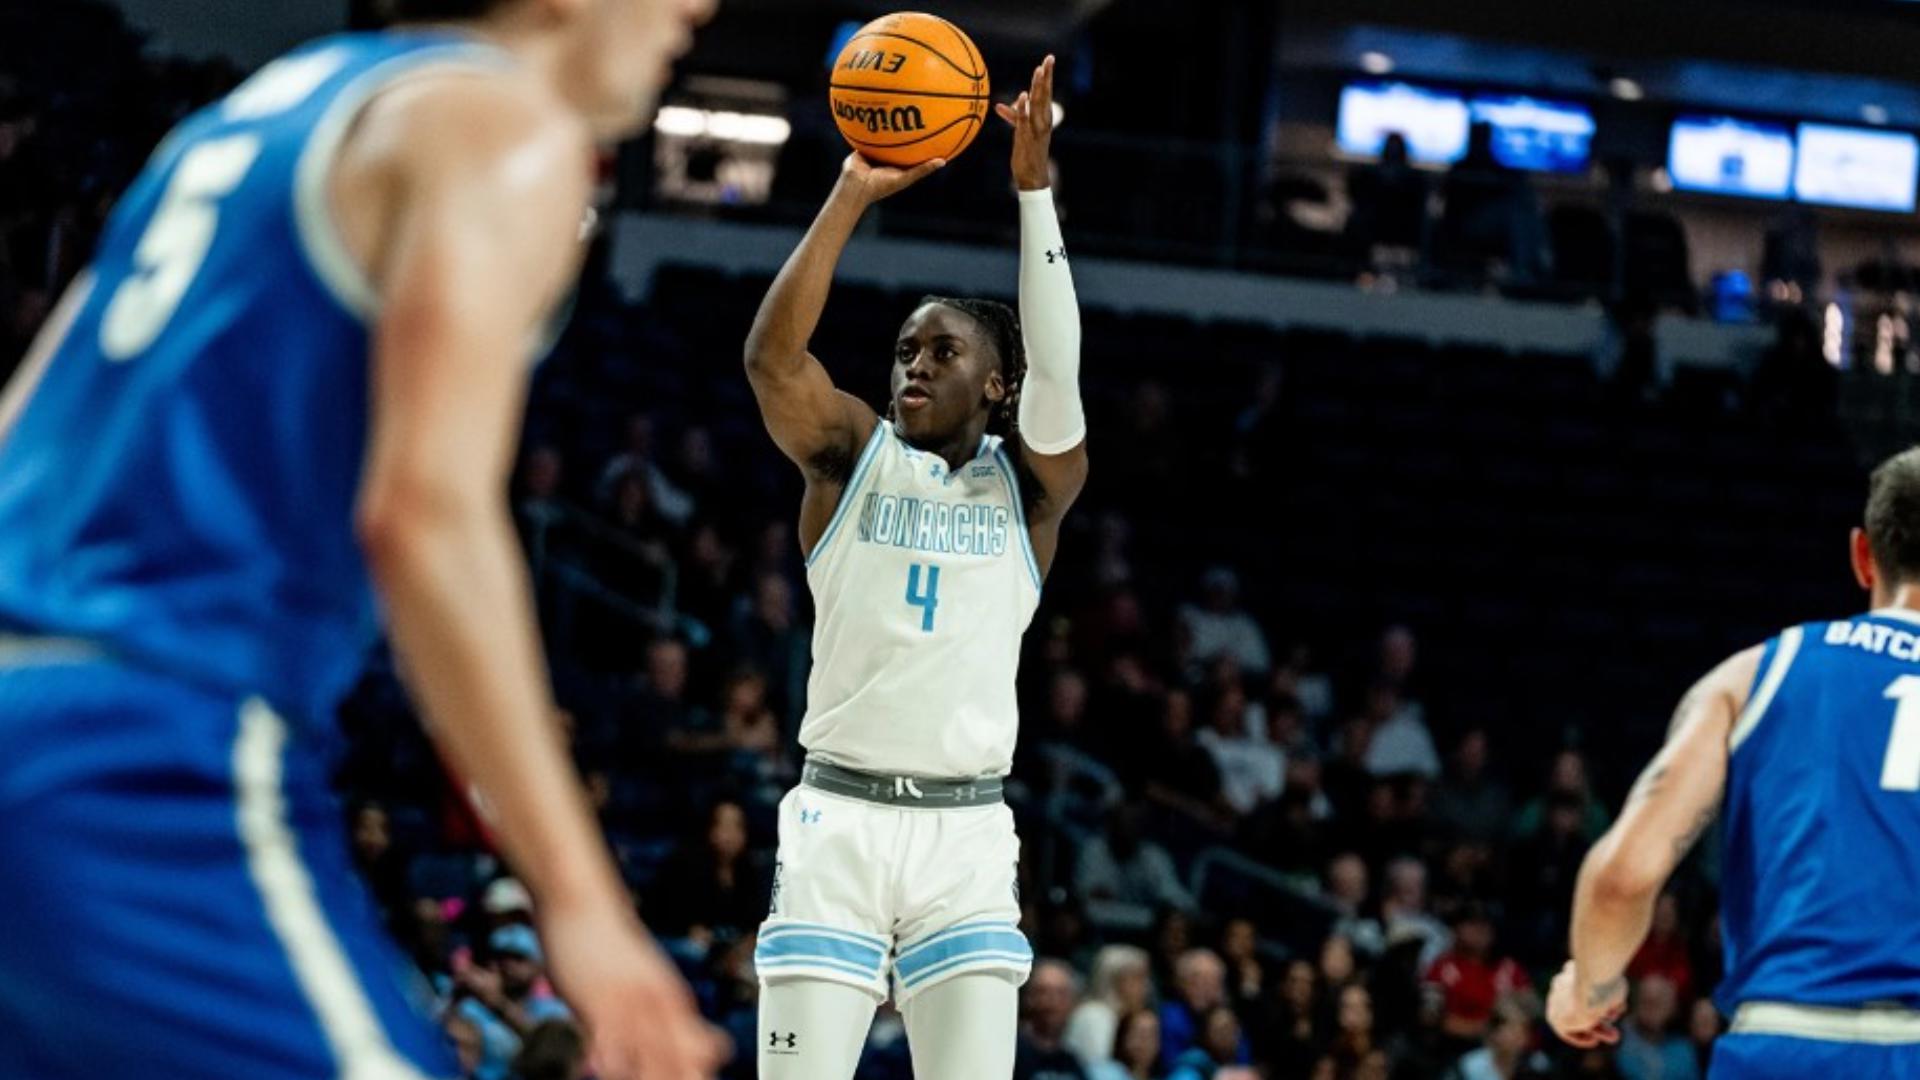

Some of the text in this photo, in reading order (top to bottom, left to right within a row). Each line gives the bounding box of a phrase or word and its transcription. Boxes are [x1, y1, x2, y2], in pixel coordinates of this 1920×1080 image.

[833, 98, 925, 133] Wilson
[101, 134, 260, 362] 5
[905, 563, 940, 632] 4
[1881, 674, 1920, 792] 1
